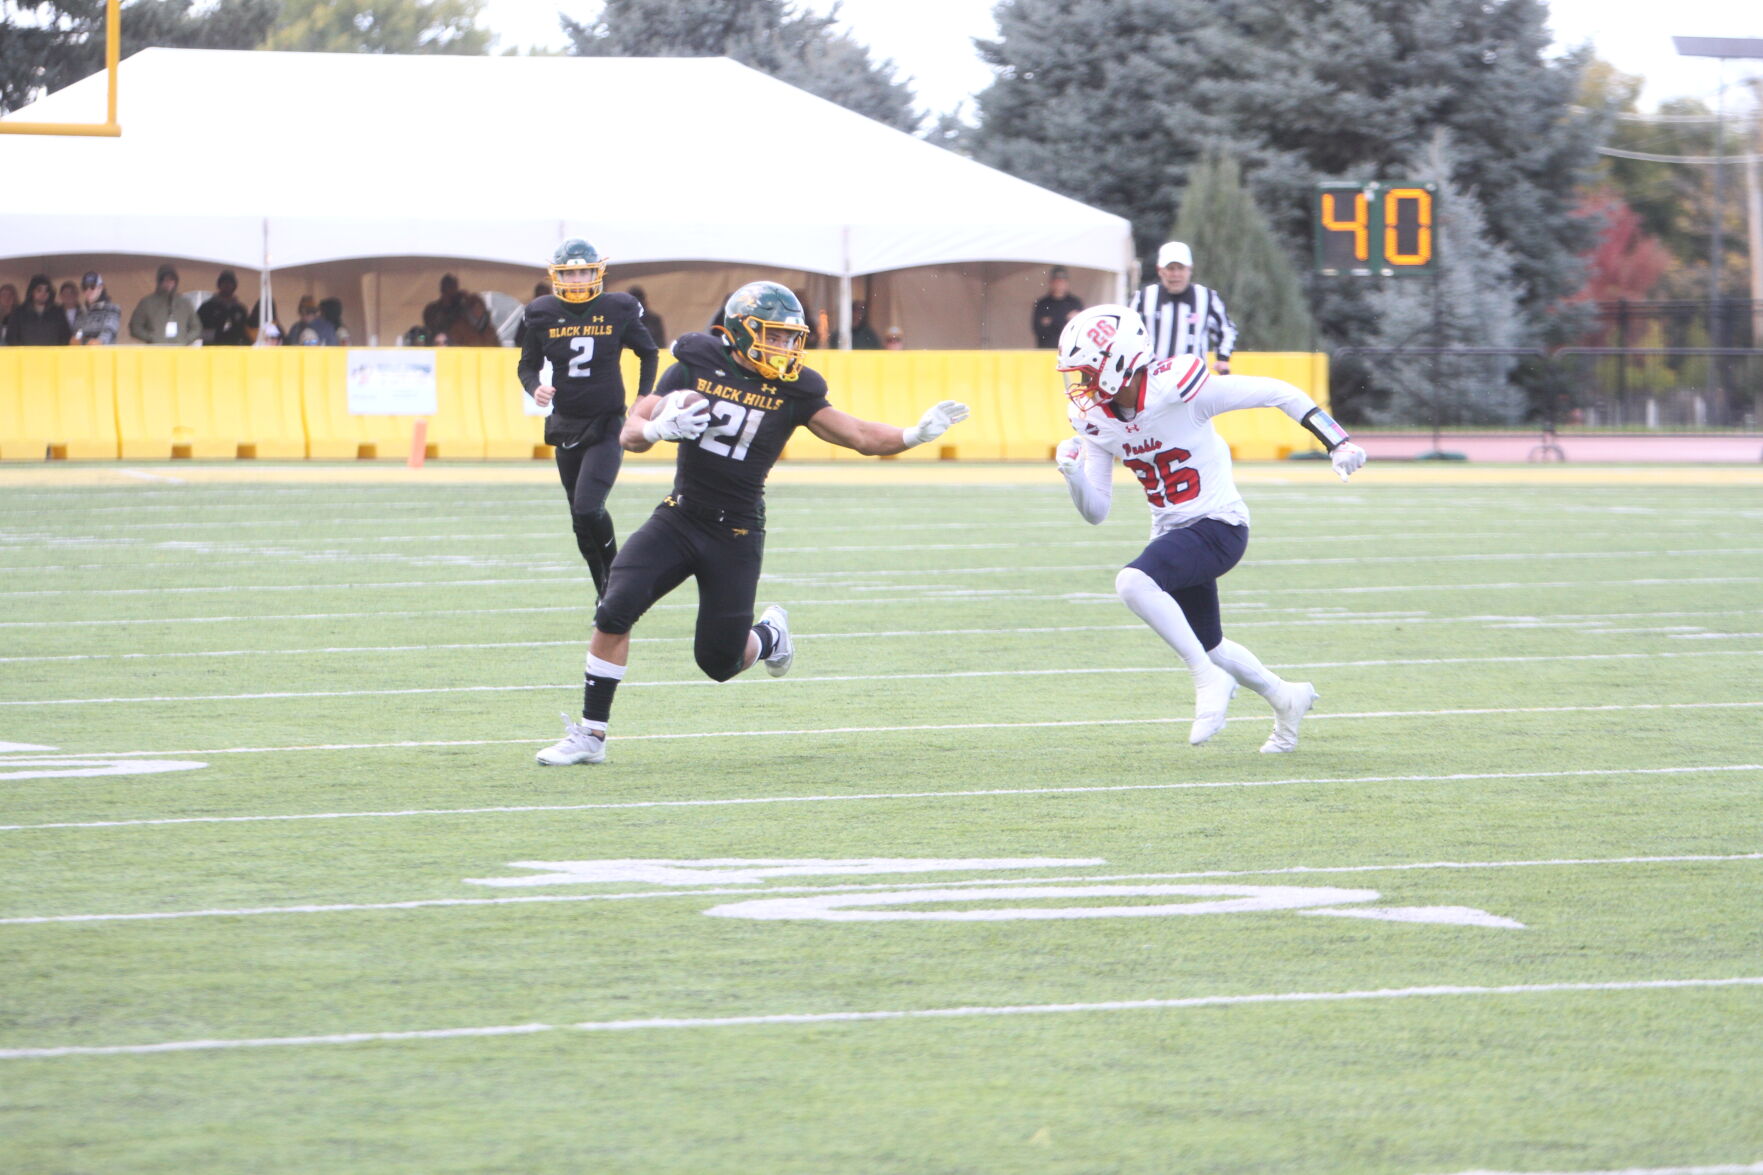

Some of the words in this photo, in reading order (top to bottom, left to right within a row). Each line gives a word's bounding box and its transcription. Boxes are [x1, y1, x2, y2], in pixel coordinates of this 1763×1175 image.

[1321, 188, 1432, 266] 40
[549, 326, 581, 339] BLACK
[583, 324, 613, 336] HILLS
[1087, 319, 1117, 350] 26
[568, 336, 595, 378] 2
[697, 377, 742, 402] BLACK
[743, 391, 784, 411] HILLS
[699, 400, 766, 461] 21
[1122, 437, 1163, 457] Pueblo
[1123, 447, 1201, 508] 26
